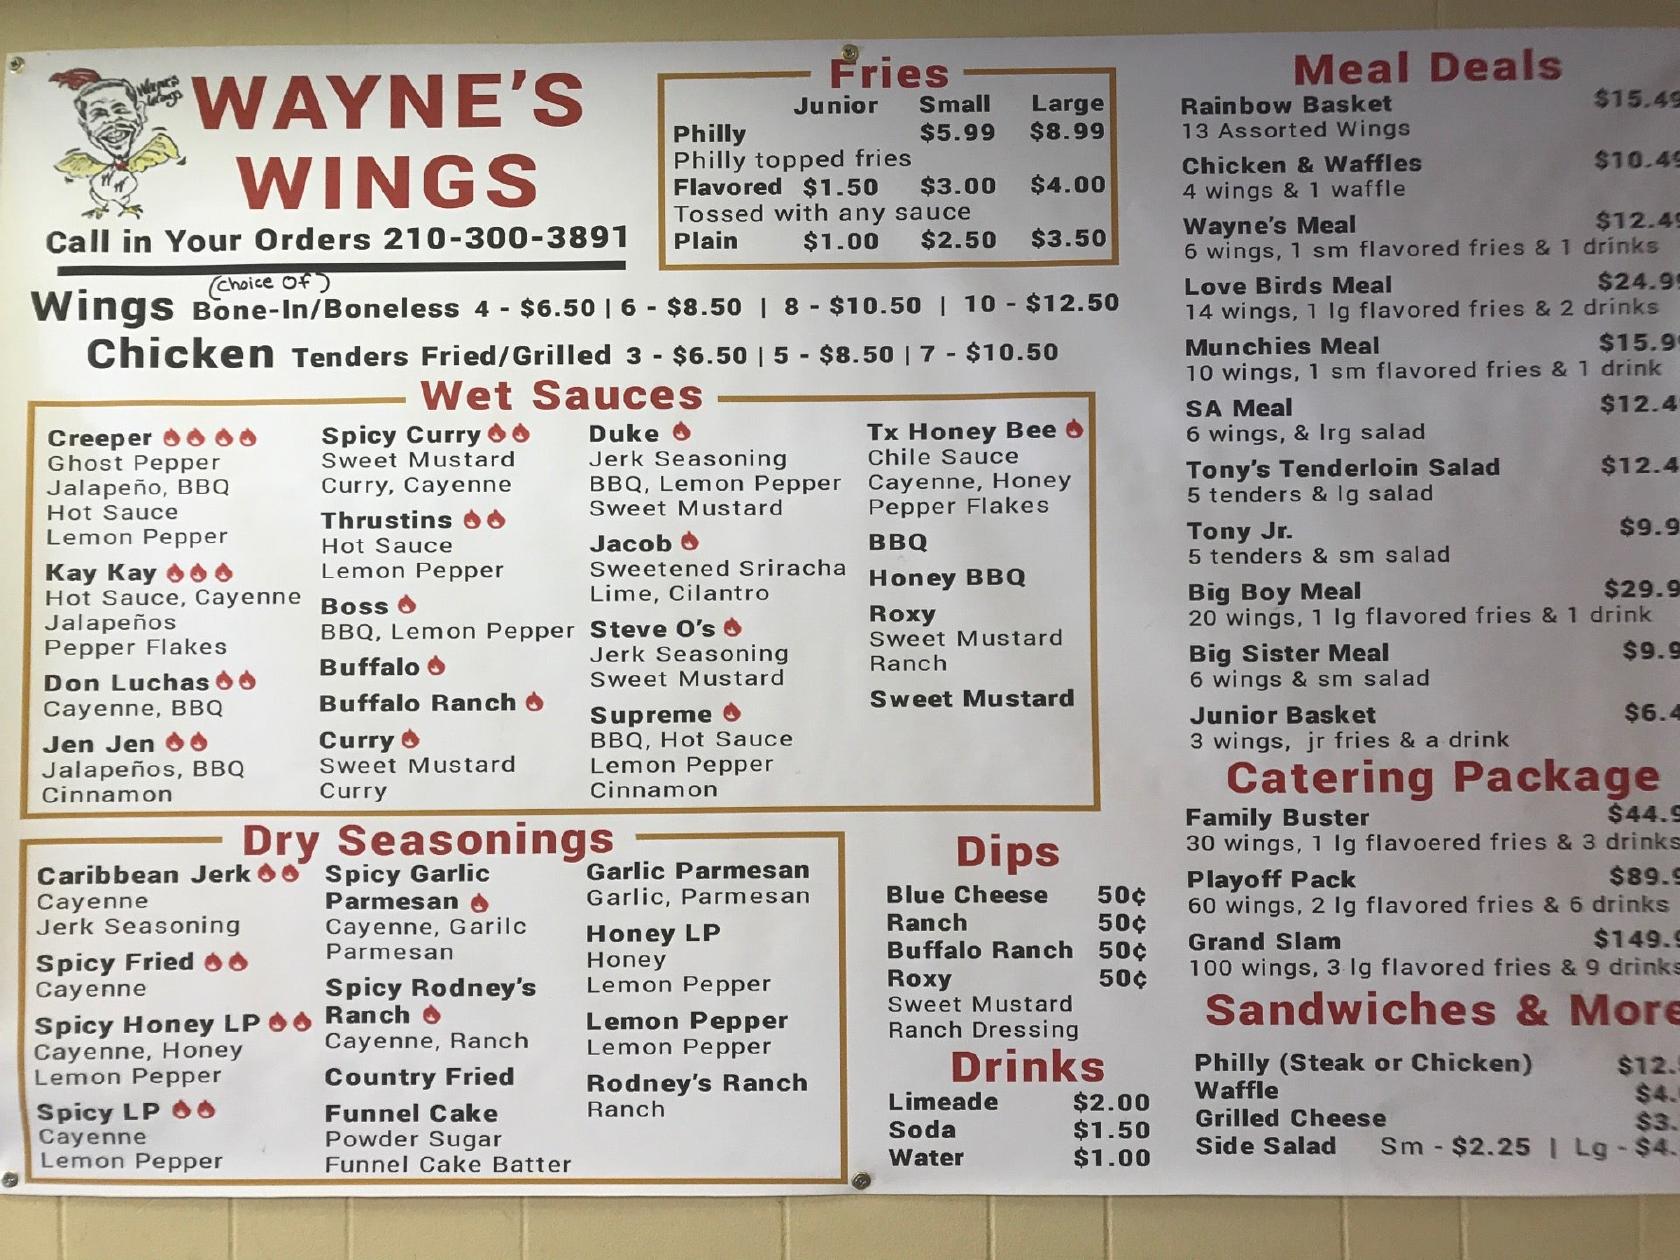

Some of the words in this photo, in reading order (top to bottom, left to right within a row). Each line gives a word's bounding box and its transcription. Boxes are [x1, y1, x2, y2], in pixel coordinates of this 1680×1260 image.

[831, 56, 949, 89] Fries
[1295, 51, 1408, 85] Meal
[1431, 48, 1562, 82] Deals
[192, 70, 582, 129] WAYNE'S
[794, 95, 878, 115] Junior
[920, 94, 990, 113] Small
[1033, 95, 1104, 115] Large
[1182, 96, 1291, 115] Rainbow
[1304, 95, 1392, 113] Basket
[674, 124, 746, 146] Philly
[921, 122, 994, 143] $5.99
[1030, 121, 1104, 142] $8.99
[1183, 123, 1208, 139] 13
[1218, 121, 1326, 138] Assorted
[1337, 120, 1410, 140] Wings
[675, 151, 745, 173] Philly
[755, 149, 843, 172] topped
[856, 149, 911, 166] fries
[1183, 156, 1286, 175] Chicken
[1298, 156, 1314, 173] &
[1324, 153, 1421, 172] Waffles
[236, 154, 536, 209] WINGS
[675, 177, 781, 196] Flavored
[803, 177, 878, 198] $1.50
[921, 176, 995, 197] $3.00
[1031, 174, 1105, 195] $4.00
[674, 204, 762, 222] Tossed
[774, 203, 827, 221] with
[839, 207, 885, 225] any
[896, 207, 970, 220] sauce
[1183, 216, 1286, 239] Wayne's
[1298, 215, 1355, 234] Meal
[47, 229, 109, 254] Call
[124, 229, 151, 253] in
[165, 230, 241, 252] Your
[255, 227, 370, 251] Orders
[384, 225, 626, 249] 210-300-3891
[675, 231, 737, 249] Plain
[804, 231, 878, 252] $1.00
[921, 229, 996, 250] $2.50
[1032, 228, 1106, 249] $3.50
[31, 289, 173, 329] Wings
[193, 297, 459, 320] Bone-In/Boneless
[475, 301, 489, 317] 4
[521, 297, 594, 319] $6.50
[622, 298, 636, 316] 6
[668, 297, 741, 318] $8.50
[785, 298, 798, 315] 8
[830, 295, 920, 317] $10.50
[965, 295, 995, 312] 10
[1026, 292, 1119, 314] $12.50
[88, 337, 273, 369] Chicken
[292, 346, 408, 367] Tenders
[422, 344, 610, 367] Fried/Grilled
[420, 381, 512, 410] Wet
[533, 380, 702, 410] Sauces
[1186, 400, 1222, 417] SA
[1234, 398, 1292, 417] Meal
[48, 430, 152, 451] Creeper
[322, 425, 396, 448] Spicy
[407, 426, 481, 447] Curry
[590, 424, 658, 442] Duke
[867, 424, 898, 440] Tx
[910, 423, 996, 444] Honey
[1007, 422, 1056, 438] Bee
[48, 455, 122, 471] Ghost
[135, 455, 220, 474] Pepper
[869, 448, 930, 465] Chile
[942, 449, 1018, 465] Sauce
[47, 479, 166, 499] Jalapeño,
[179, 479, 228, 496] BBQ
[1188, 487, 1200, 503] 5
[1209, 486, 1301, 503] tenders
[1312, 486, 1327, 501] &
[1339, 485, 1358, 505] lg
[1369, 484, 1432, 501] salad
[321, 510, 452, 529] Thrustins
[590, 534, 672, 552] Jacob
[1187, 522, 1251, 544] Tony
[1261, 522, 1292, 539] Jr.
[323, 538, 364, 554] Hot
[376, 538, 452, 553] Sauce
[46, 564, 96, 585] Kay
[108, 564, 157, 585] Kay
[591, 560, 728, 577] Sweetened
[740, 559, 845, 576] Sriracha
[870, 570, 956, 591] Honey
[967, 568, 1025, 587] BBQ
[322, 598, 388, 615] Boss
[870, 605, 936, 627] Roxy
[322, 624, 380, 641] BBQ,
[392, 624, 475, 639] Lemon
[488, 623, 574, 642] Pepper
[591, 620, 667, 638] Steve
[677, 619, 715, 637] O's
[1190, 644, 1230, 667] Big
[1243, 643, 1320, 662] Sister
[1329, 643, 1388, 662] Meal
[871, 690, 953, 708] Sweet
[964, 688, 1074, 707] Mustard
[591, 706, 711, 727] Supreme
[1228, 759, 1432, 801] Catering
[1455, 759, 1660, 800] Package
[43, 786, 171, 803] Cinnamon
[244, 825, 319, 864] Dry
[339, 822, 613, 863] Seasonings
[958, 833, 1059, 875] Dips
[38, 865, 178, 885] Caribbean
[191, 864, 251, 883] Jerk
[326, 864, 400, 887] Spicy
[411, 863, 489, 883] Garlic
[587, 861, 664, 880] Garlic
[676, 862, 809, 879] Parmesan
[38, 894, 148, 913] Cayenne
[887, 885, 944, 904] Blue
[955, 885, 1048, 903] Cheese
[1098, 886, 1145, 906] 50¢
[326, 919, 438, 938] Cayenne,
[450, 917, 526, 934] Garilc
[1189, 932, 1264, 951] Grand
[1277, 932, 1340, 950] Slam
[36, 953, 115, 976] Spicy
[126, 952, 193, 970] Fried
[888, 969, 952, 991] Roxy
[1100, 969, 1147, 989] 50¢
[1206, 991, 1495, 1026] Sandwiches
[1516, 994, 1549, 1026] &
[1570, 994, 1680, 1026] More
[952, 1048, 1104, 1082] Drinks
[1195, 1053, 1270, 1076] Philly
[1280, 1053, 1365, 1076] (Steak
[1375, 1058, 1403, 1071] or
[1412, 1053, 1532, 1076] Chicken)
[325, 1068, 436, 1090] Country
[446, 1067, 514, 1086] Fried
[588, 1073, 711, 1096] Rodney's
[724, 1073, 807, 1092] Ranch
[890, 1092, 998, 1110] Limeade
[1074, 1091, 1149, 1113] $2.00
[37, 1103, 114, 1125] Spicy
[124, 1103, 160, 1120] LP
[326, 1130, 418, 1147] Powder
[430, 1131, 502, 1151] Sugar
[1196, 1136, 1254, 1155] Side
[1264, 1136, 1336, 1155] Salad
[1381, 1137, 1423, 1155] Sm
[1453, 1135, 1530, 1157] $2.25
[889, 1149, 964, 1166] Water
[1074, 1146, 1150, 1168] $1.00
